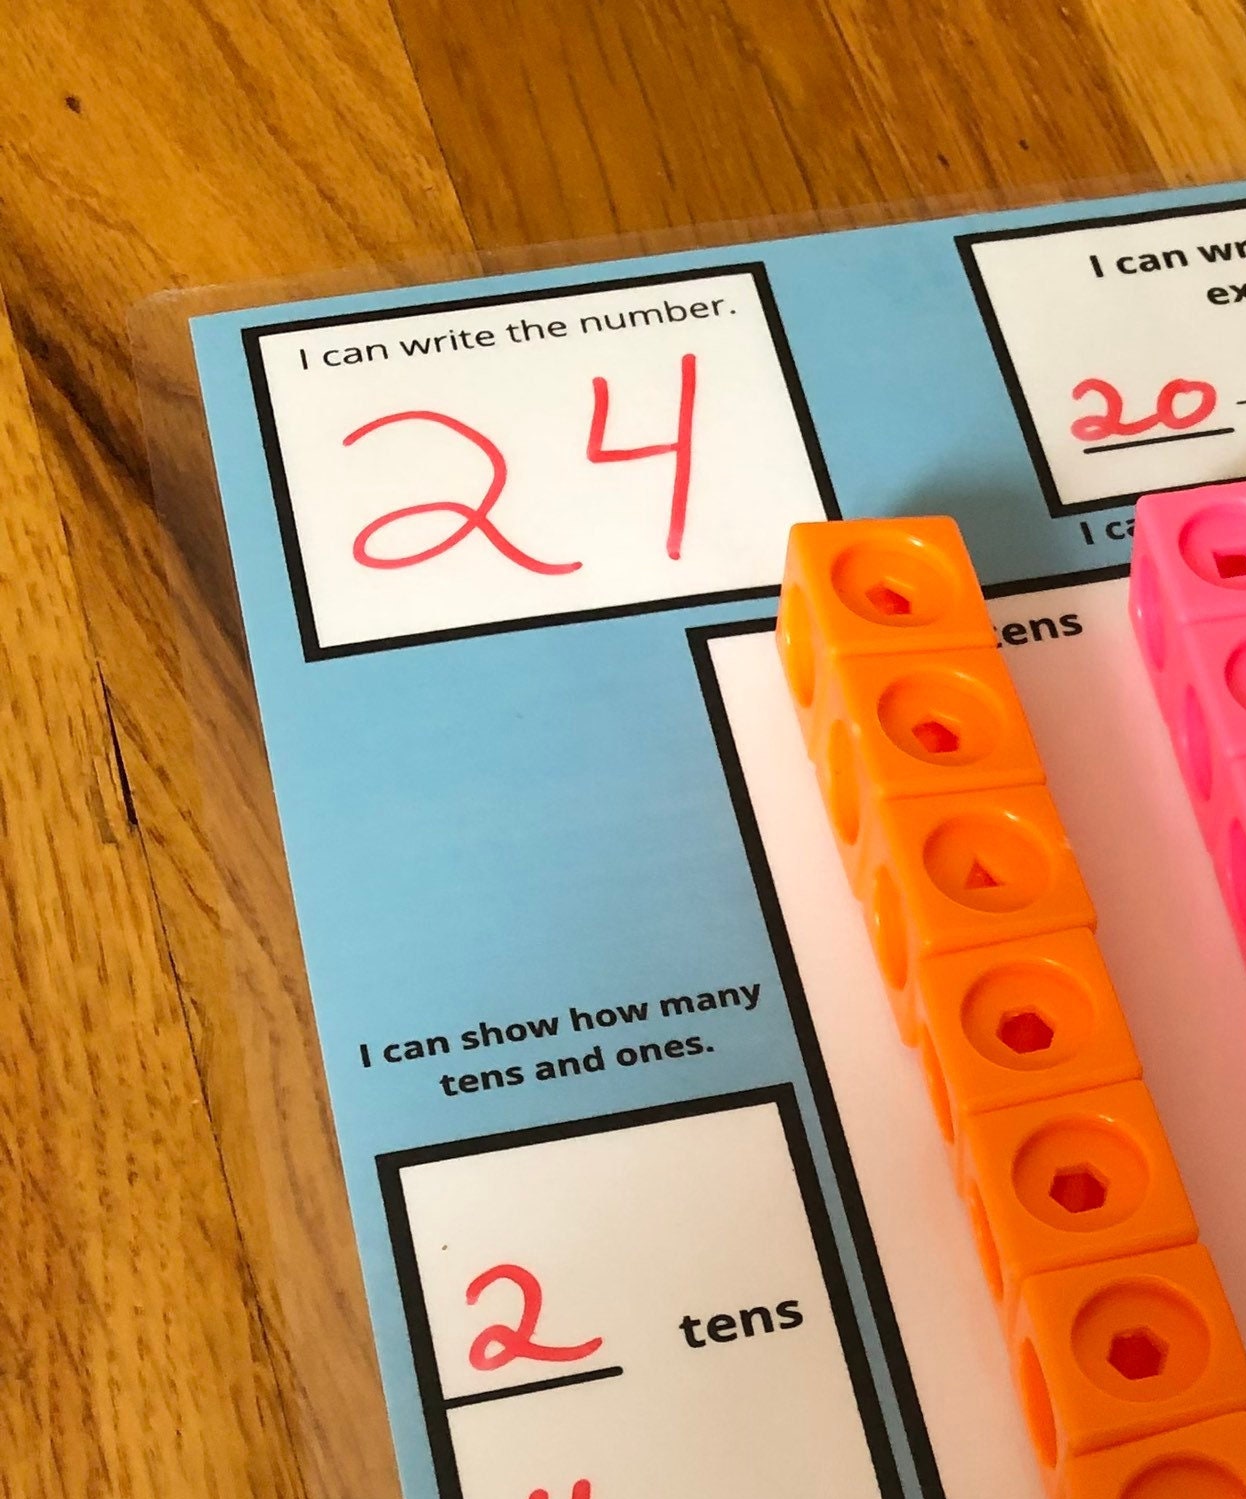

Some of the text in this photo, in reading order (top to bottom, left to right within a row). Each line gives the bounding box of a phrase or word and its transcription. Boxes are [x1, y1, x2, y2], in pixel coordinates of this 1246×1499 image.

[1090, 254, 1105, 278] I
[1117, 249, 1189, 275] can
[300, 295, 737, 371] I can write the number.
[1071, 377, 1218, 442] 20
[342, 352, 697, 576] 24
[1080, 521, 1095, 546] I
[993, 612, 1084, 649] ens
[360, 983, 761, 1068] I can show how many
[440, 1035, 715, 1097] tens and ones.
[465, 1263, 804, 1371] 2 tens
